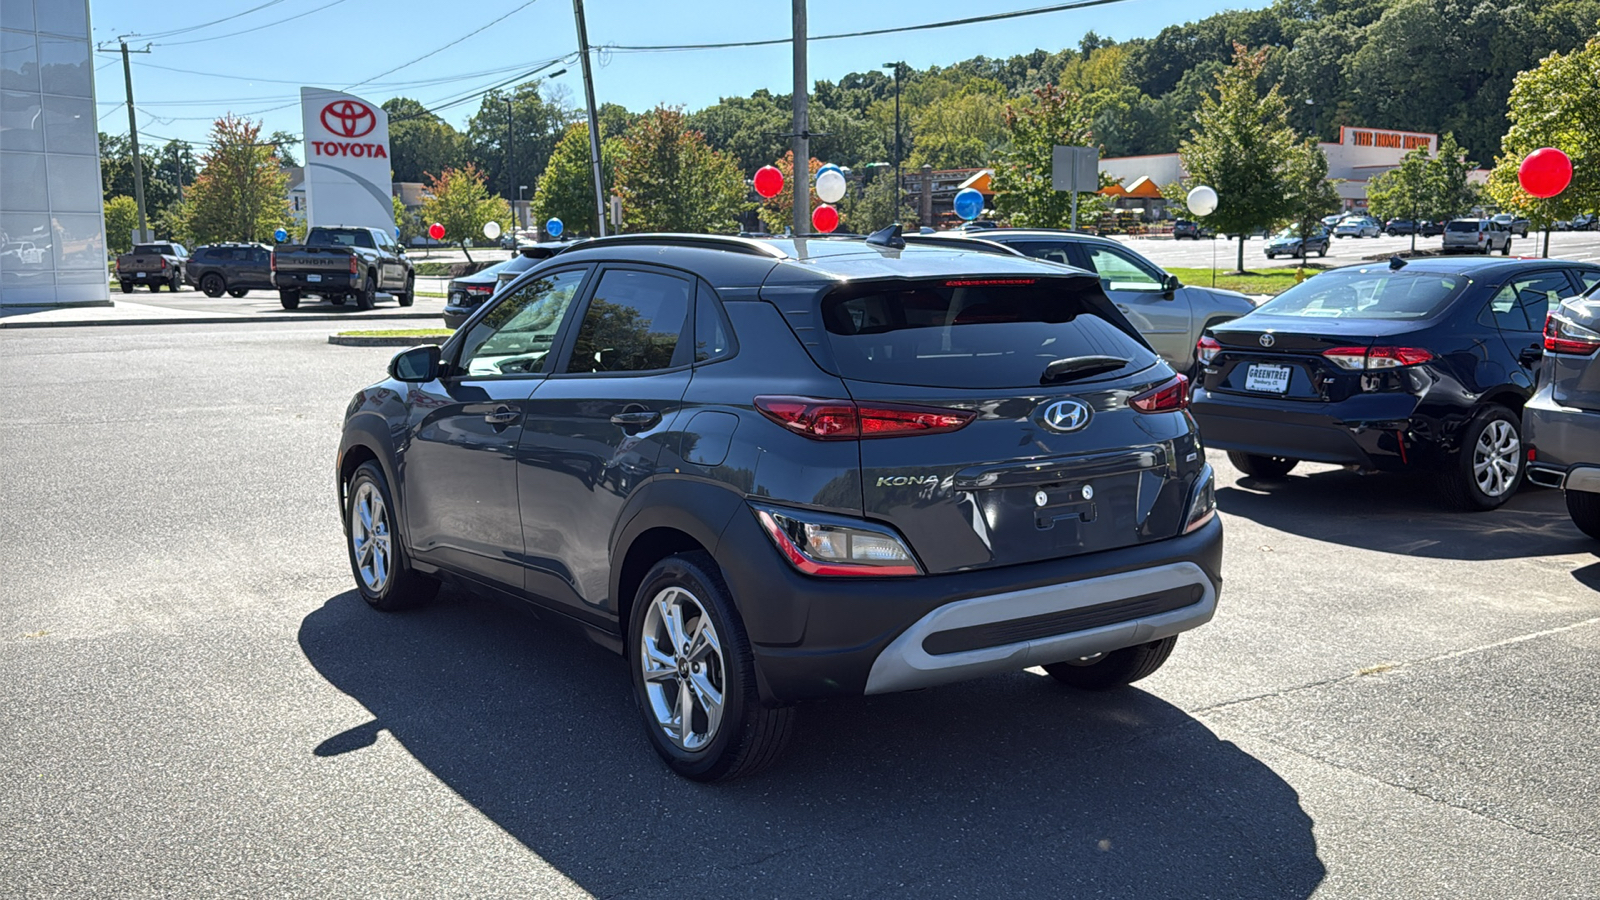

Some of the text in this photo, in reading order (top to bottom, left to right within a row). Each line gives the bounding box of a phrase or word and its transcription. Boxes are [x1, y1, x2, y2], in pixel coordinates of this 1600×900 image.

[1353, 131, 1431, 150] THE HOME DEPOT
[311, 141, 388, 159] TOYOTA
[293, 258, 335, 266] TUNDRA
[1248, 368, 1288, 381] GREENTREE
[876, 475, 939, 487] KONA
